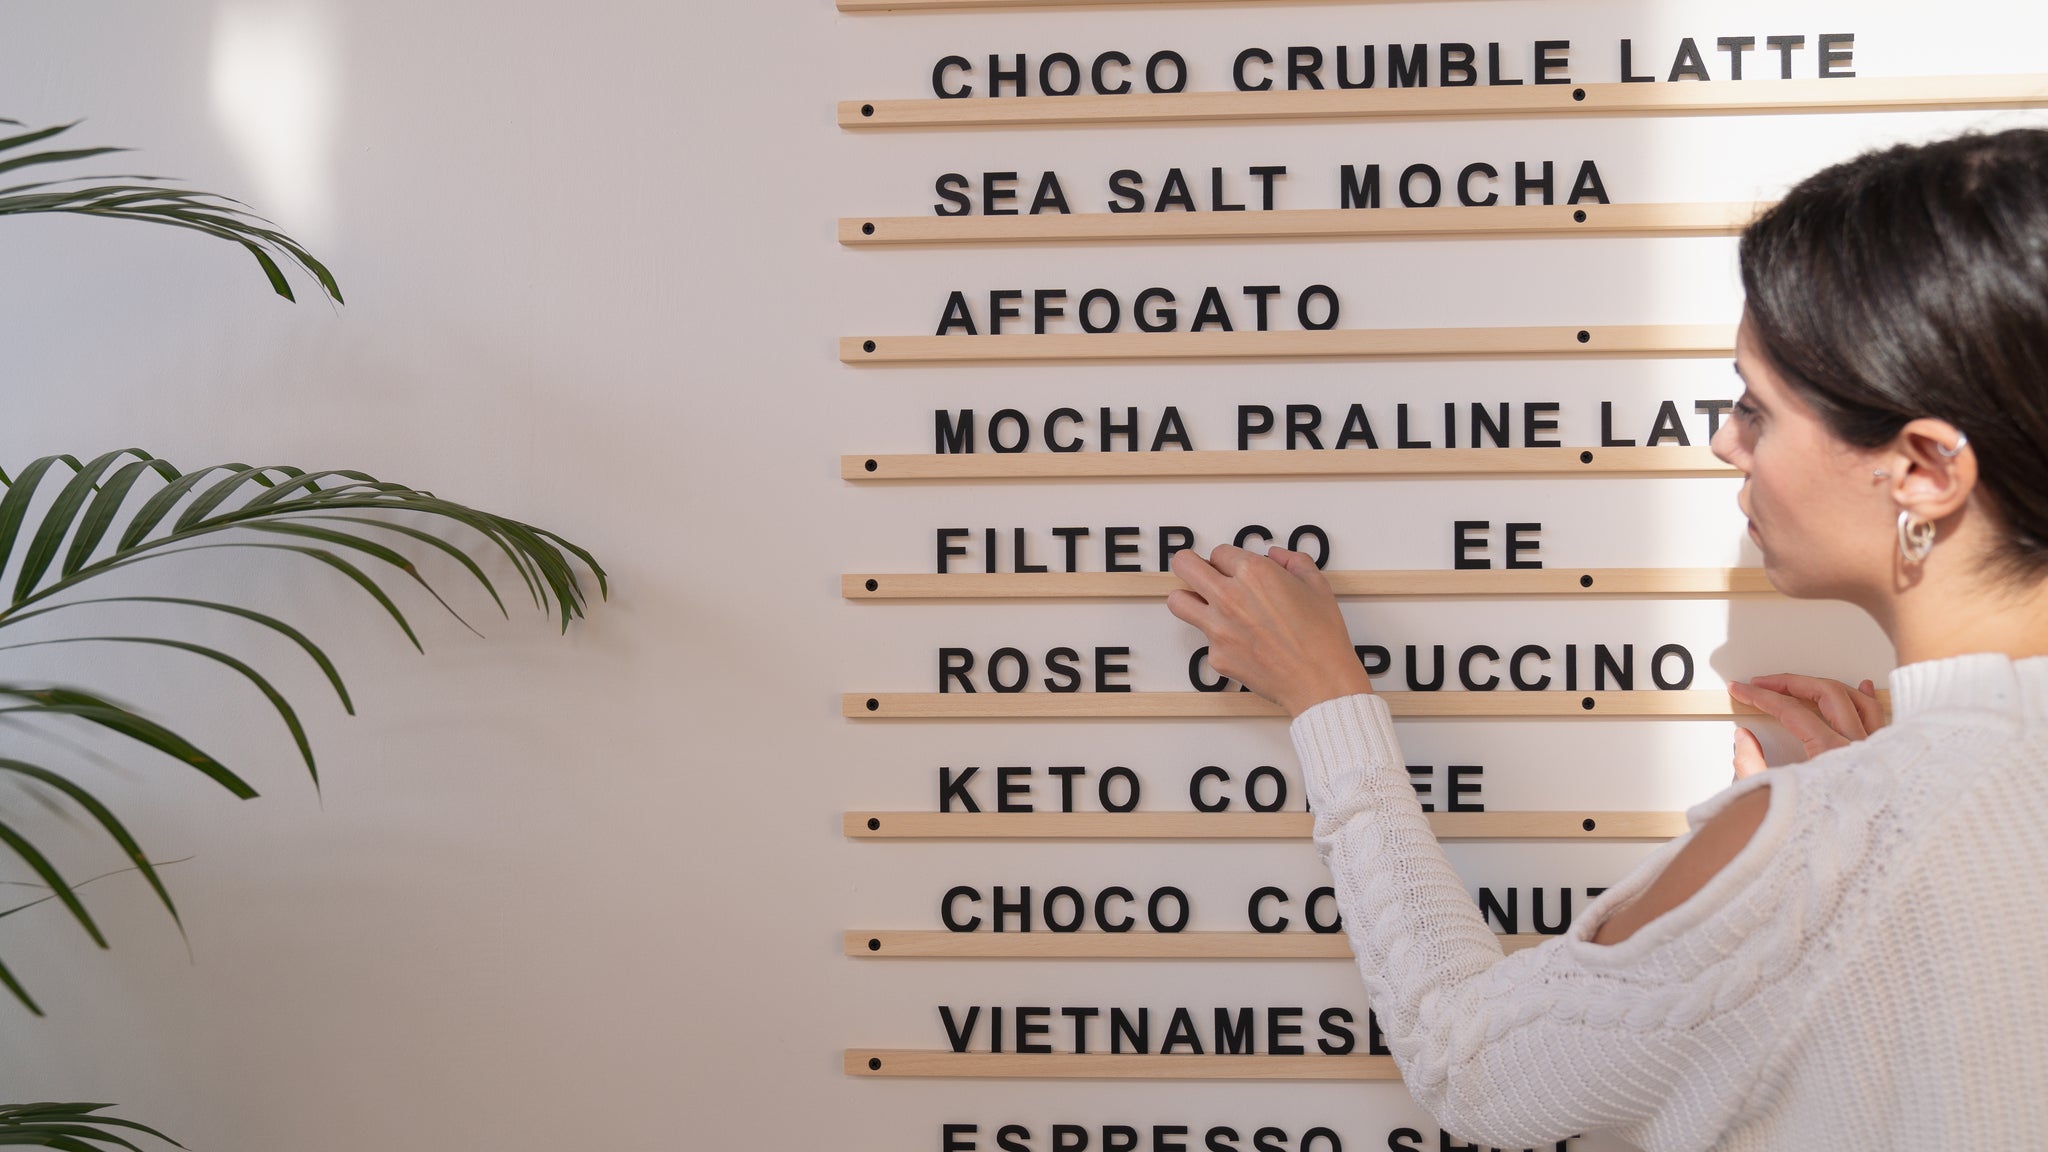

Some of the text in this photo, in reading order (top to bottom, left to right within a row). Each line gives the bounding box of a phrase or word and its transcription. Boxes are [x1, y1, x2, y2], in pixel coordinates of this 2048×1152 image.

[932, 33, 1857, 99] CHOCO CRUMBLE LATTE
[934, 160, 1610, 217] SEA SALT MOCHA
[935, 284, 1340, 336] AFFOGATO
[935, 406, 1194, 455] MOCHA
[1237, 402, 1561, 451] PRALINE
[936, 525, 1195, 574] FILTER
[939, 644, 1694, 694] ROSE CPUCCINO
[939, 766, 1141, 813] KETO
[941, 885, 1608, 936] CHOCO CONU
